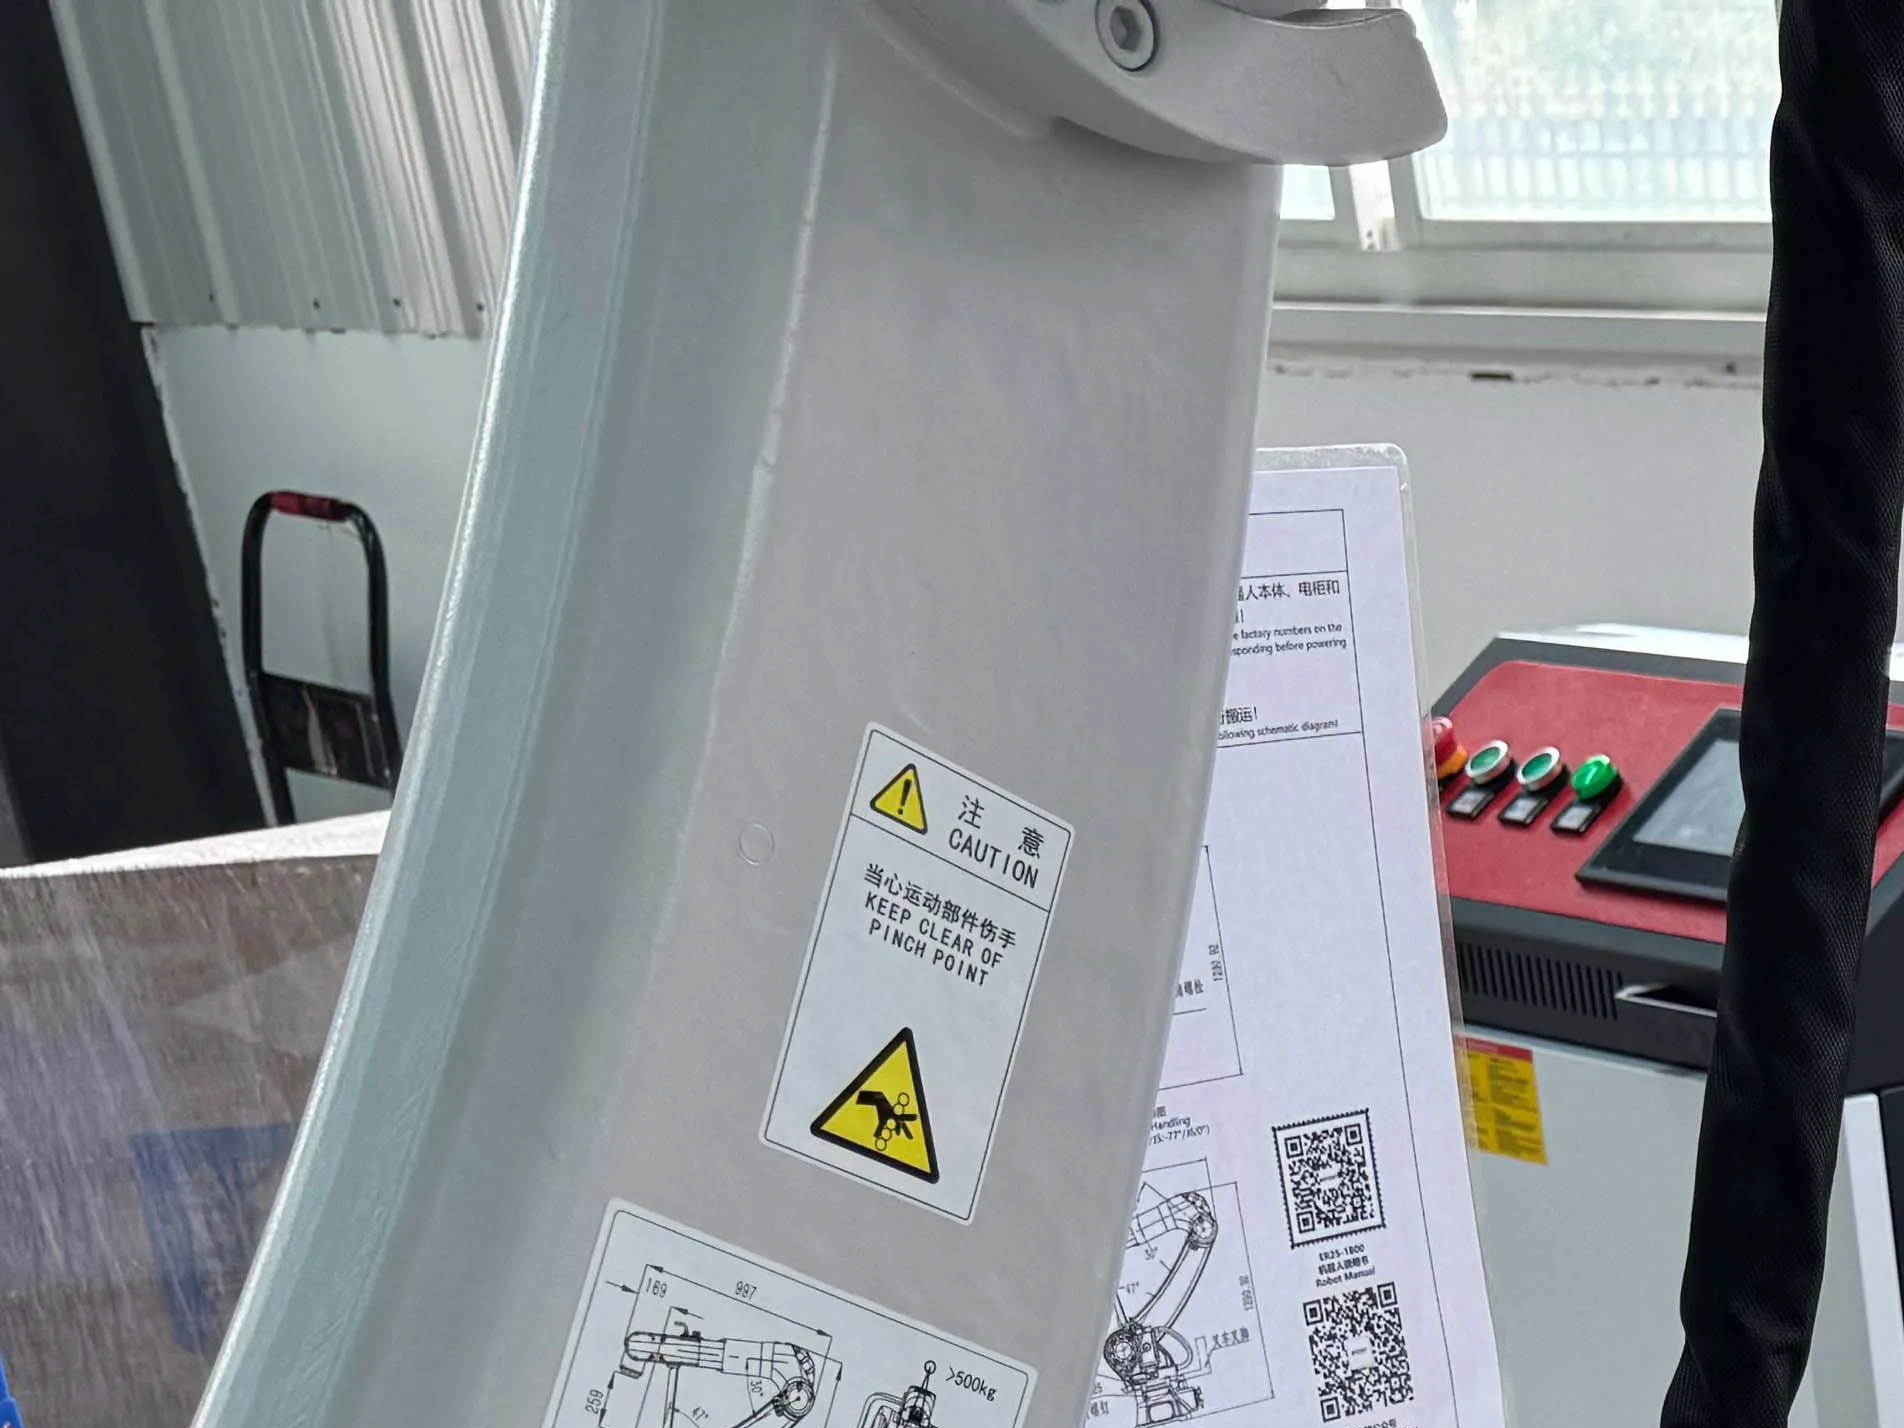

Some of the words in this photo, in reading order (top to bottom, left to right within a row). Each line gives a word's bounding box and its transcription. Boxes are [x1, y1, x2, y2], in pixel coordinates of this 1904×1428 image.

[1241, 629, 1272, 641] factory
[1274, 625, 1312, 637] numbers
[1314, 625, 1327, 635] on
[1328, 623, 1342, 633] the
[1276, 641, 1304, 652] before
[1306, 638, 1347, 652] powering
[1258, 723, 1298, 736] schematic
[949, 828, 1040, 890] CAUTION
[863, 863, 1017, 949] 当心运动部件伤手
[865, 891, 913, 924] KEEP
[919, 918, 974, 958] CLEAR
[980, 947, 1005, 969] OF
[868, 917, 925, 959] PINCH
[932, 948, 990, 987] POINT
[645, 1278, 668, 1298] 169
[946, 1366, 998, 1402] >500kg
